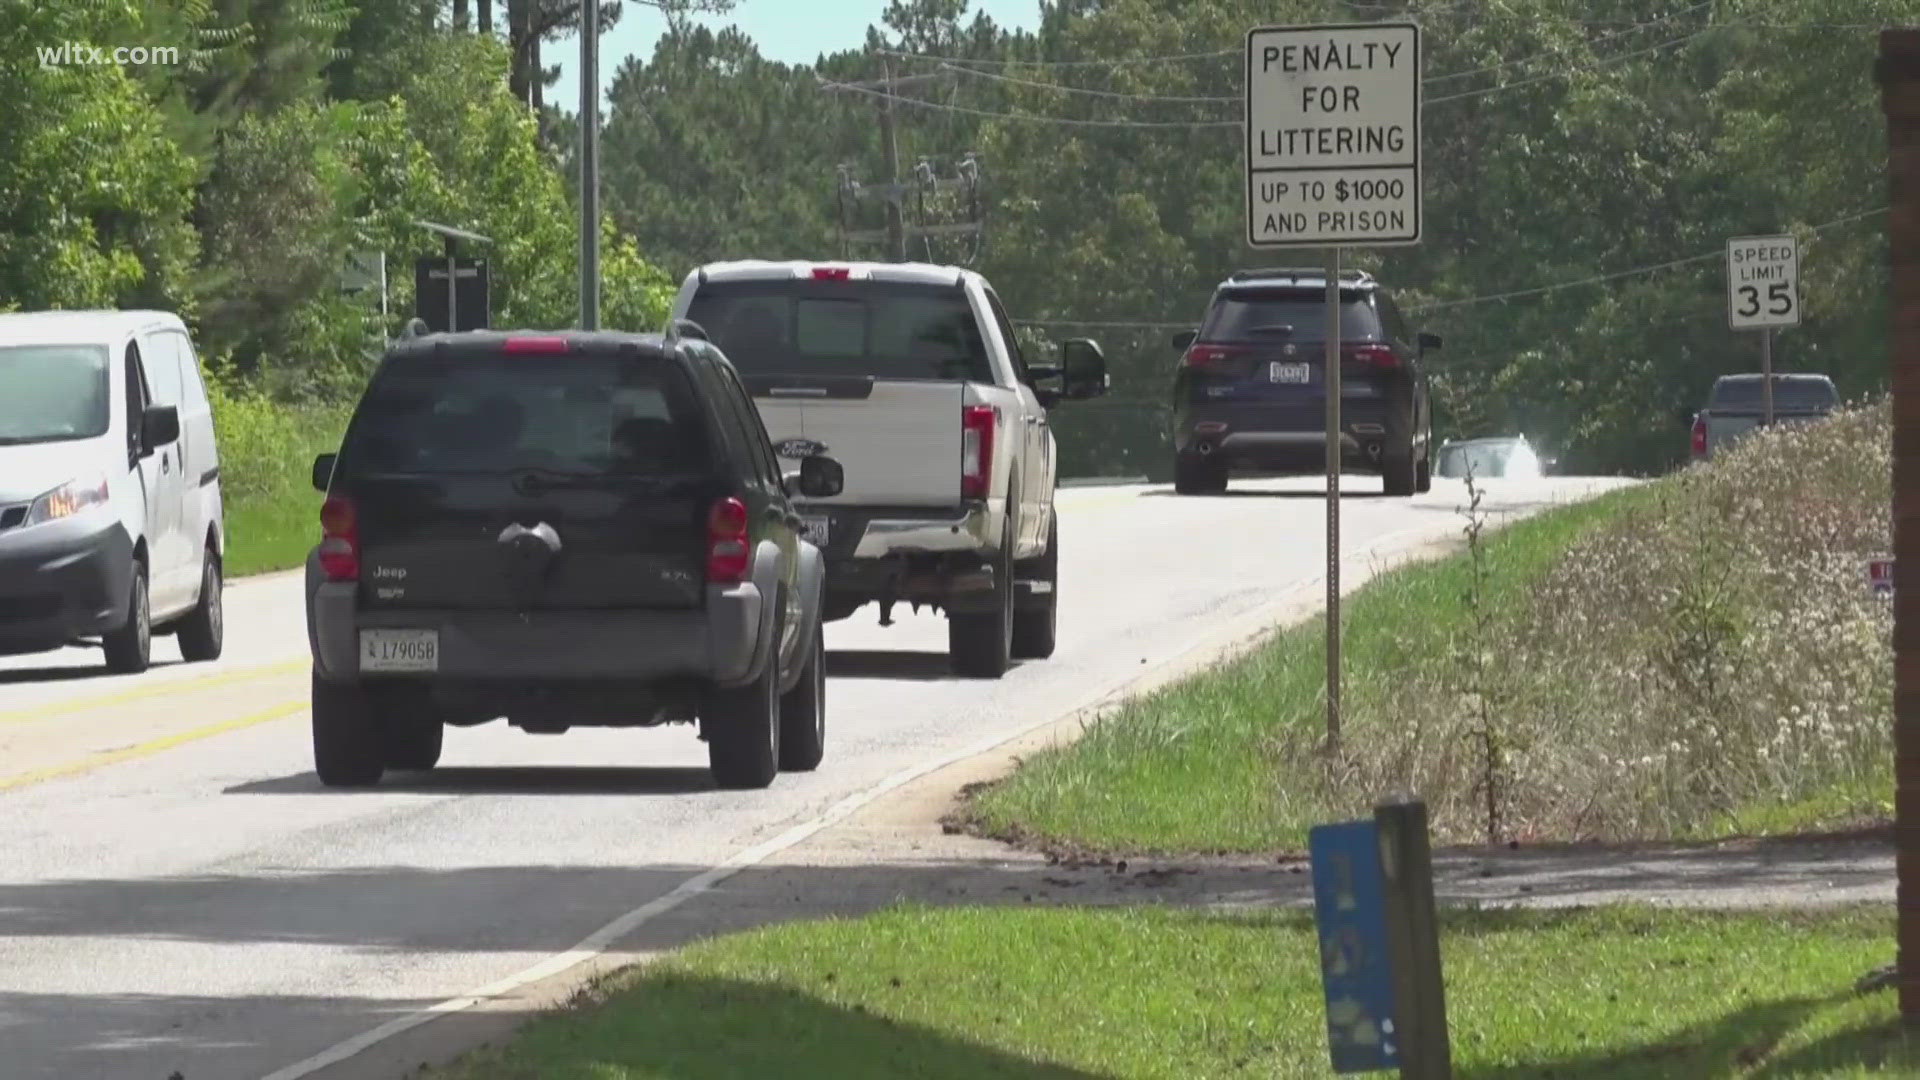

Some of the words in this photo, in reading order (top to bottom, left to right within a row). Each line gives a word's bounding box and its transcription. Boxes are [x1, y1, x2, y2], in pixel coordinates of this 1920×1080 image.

[1263, 41, 1402, 73] PENALTY
[1302, 85, 1360, 113] FOR
[1261, 125, 1404, 156] LITTERING
[1261, 182, 1289, 203] UP
[1300, 181, 1325, 203] TO
[1335, 178, 1404, 203] $1000
[1264, 213, 1307, 233] AND
[1318, 210, 1404, 232] PRISON
[1734, 246, 1792, 263] SPEED
[1740, 264, 1784, 280] LIMIT
[1738, 279, 1792, 317] 35
[373, 565, 407, 580] Jeep
